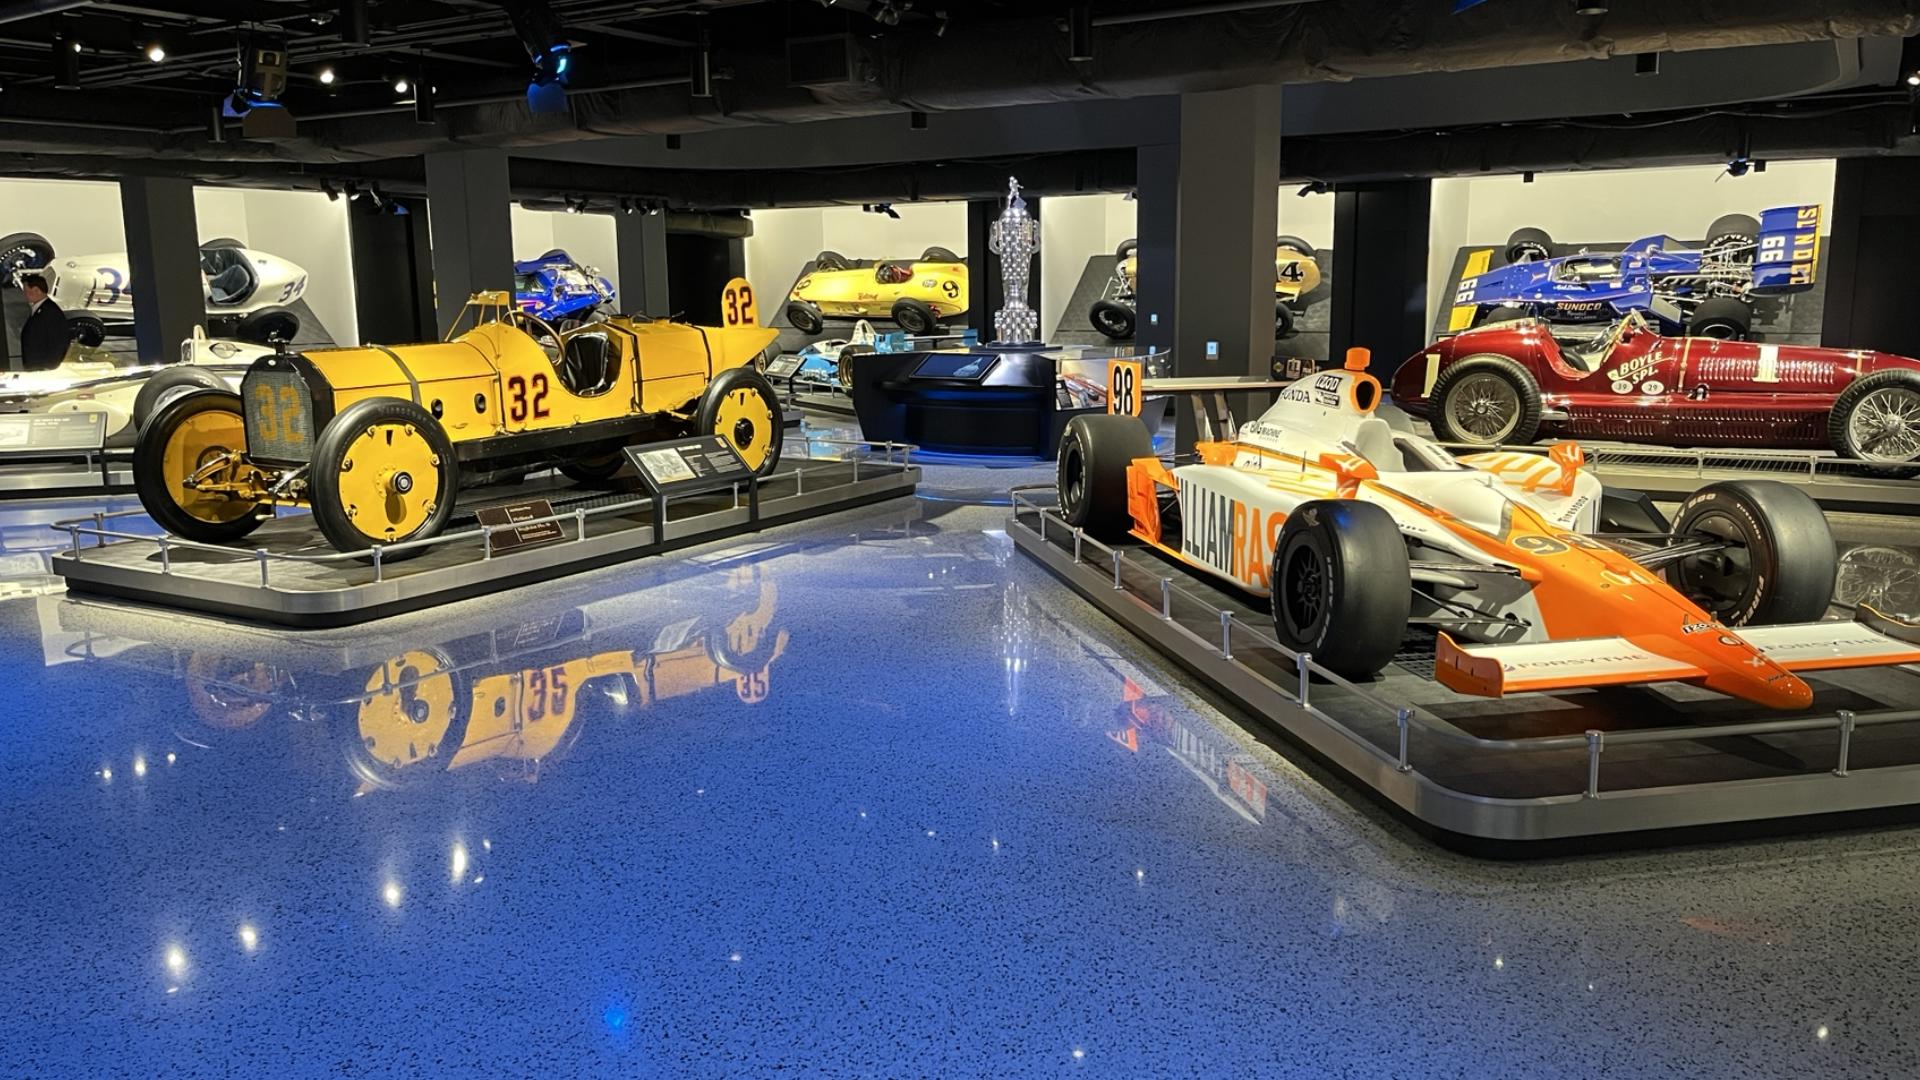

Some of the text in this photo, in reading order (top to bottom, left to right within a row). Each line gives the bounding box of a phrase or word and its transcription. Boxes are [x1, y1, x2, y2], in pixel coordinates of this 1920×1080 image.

[1760, 236, 1785, 262] 66
[1790, 207, 1817, 284] SUNOCO
[1276, 261, 1304, 282] 4
[279, 275, 307, 303] 34
[942, 280, 959, 299] 9
[1455, 278, 1478, 303] 66
[725, 285, 754, 326] 32
[1556, 302, 1602, 311] SUNOCO
[1421, 353, 1441, 398] 1
[1620, 351, 1662, 376] BOYLE
[1752, 344, 1782, 383] 1
[507, 372, 550, 422] 32
[1113, 365, 1133, 415] 98
[1315, 375, 1341, 392] IZOD
[255, 383, 304, 443] 32
[1557, 495, 1589, 524] Firestone
[1765, 637, 1888, 651] FORSYTHE
[1517, 654, 1649, 669] FORSYTHE
